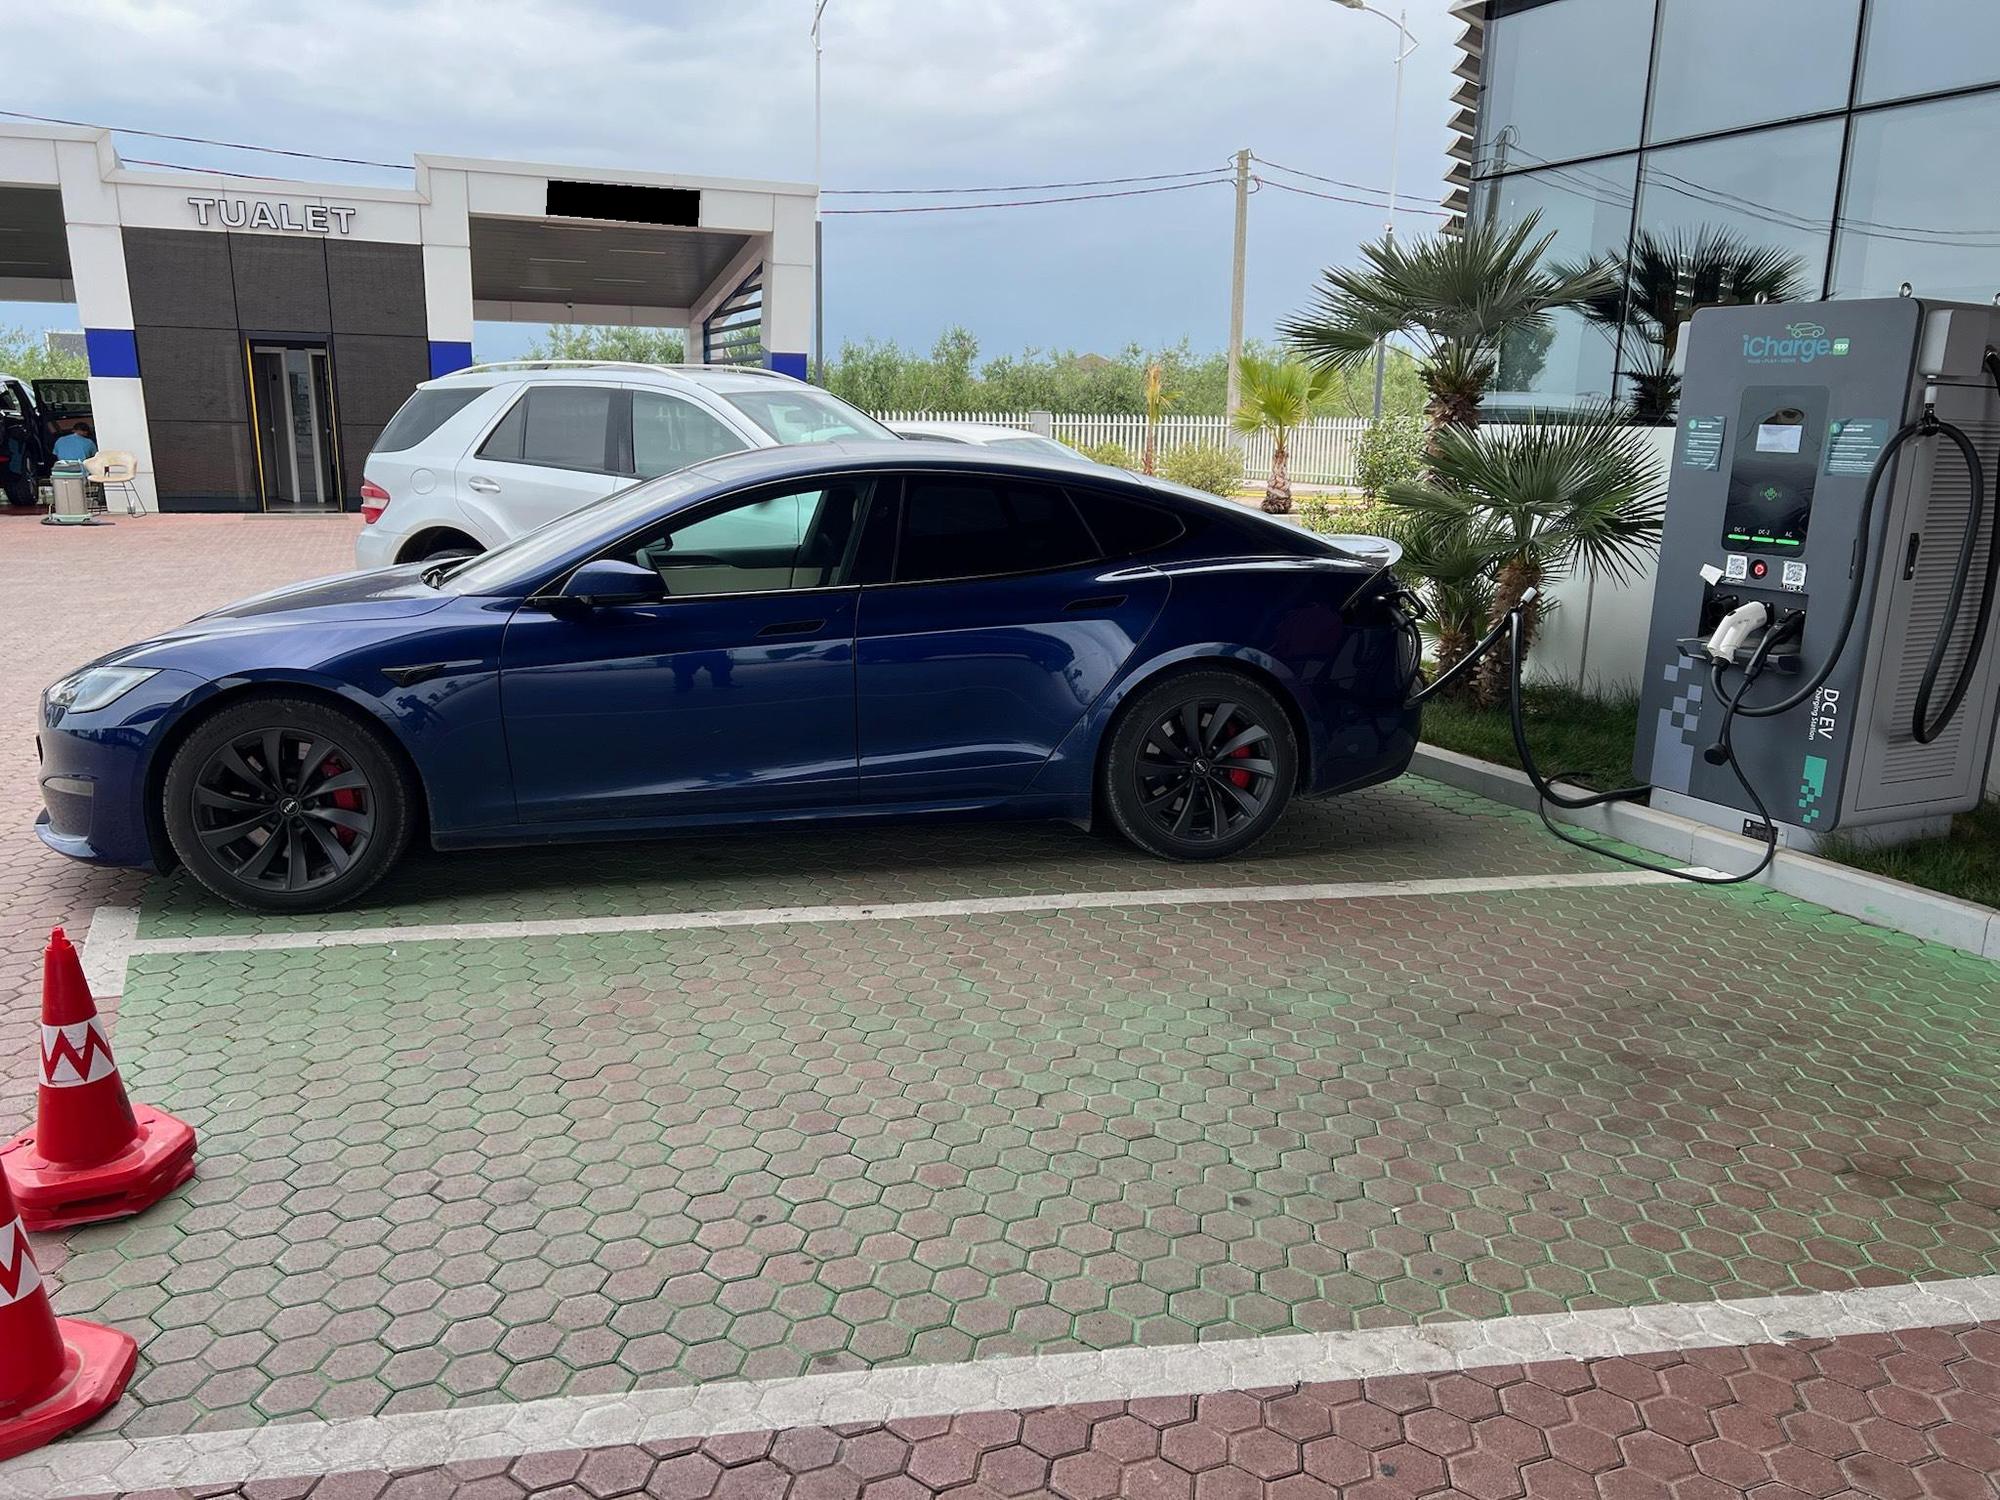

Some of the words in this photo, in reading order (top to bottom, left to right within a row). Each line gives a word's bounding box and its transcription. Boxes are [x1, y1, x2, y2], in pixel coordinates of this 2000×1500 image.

[187, 197, 356, 234] TUALET
[1821, 688, 1840, 715] DC
[1818, 716, 1836, 740] EV
